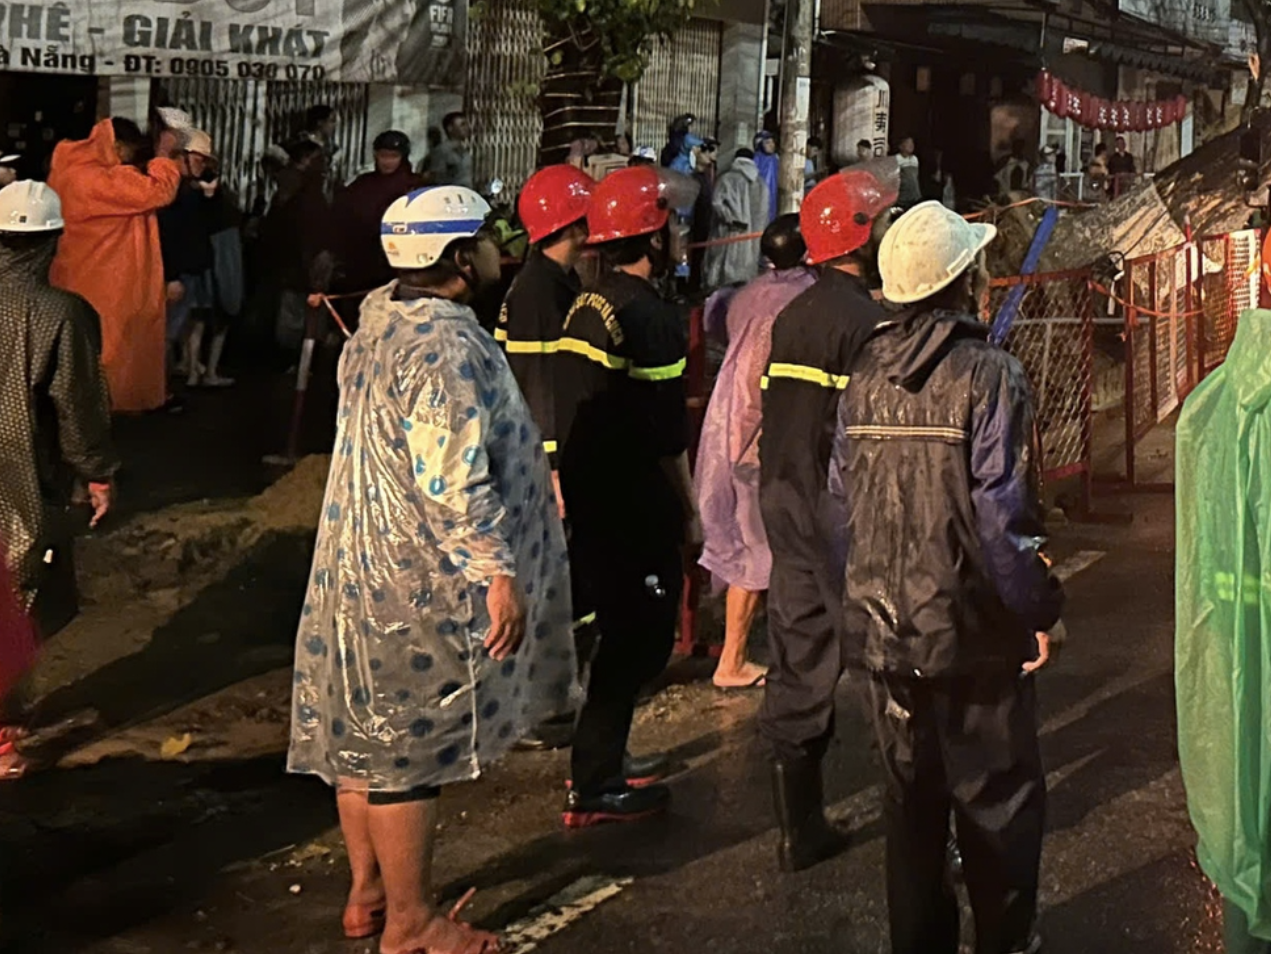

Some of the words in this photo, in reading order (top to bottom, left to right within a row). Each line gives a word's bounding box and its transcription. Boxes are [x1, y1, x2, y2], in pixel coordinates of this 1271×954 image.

[0, 1, 70, 42] HÊ
[123, 11, 212, 51] GIẢI
[229, 23, 330, 58] KHÁT
[20, 44, 95, 73] Nẵng
[124, 54, 161, 74] ĐT:
[169, 57, 229, 77] 0905
